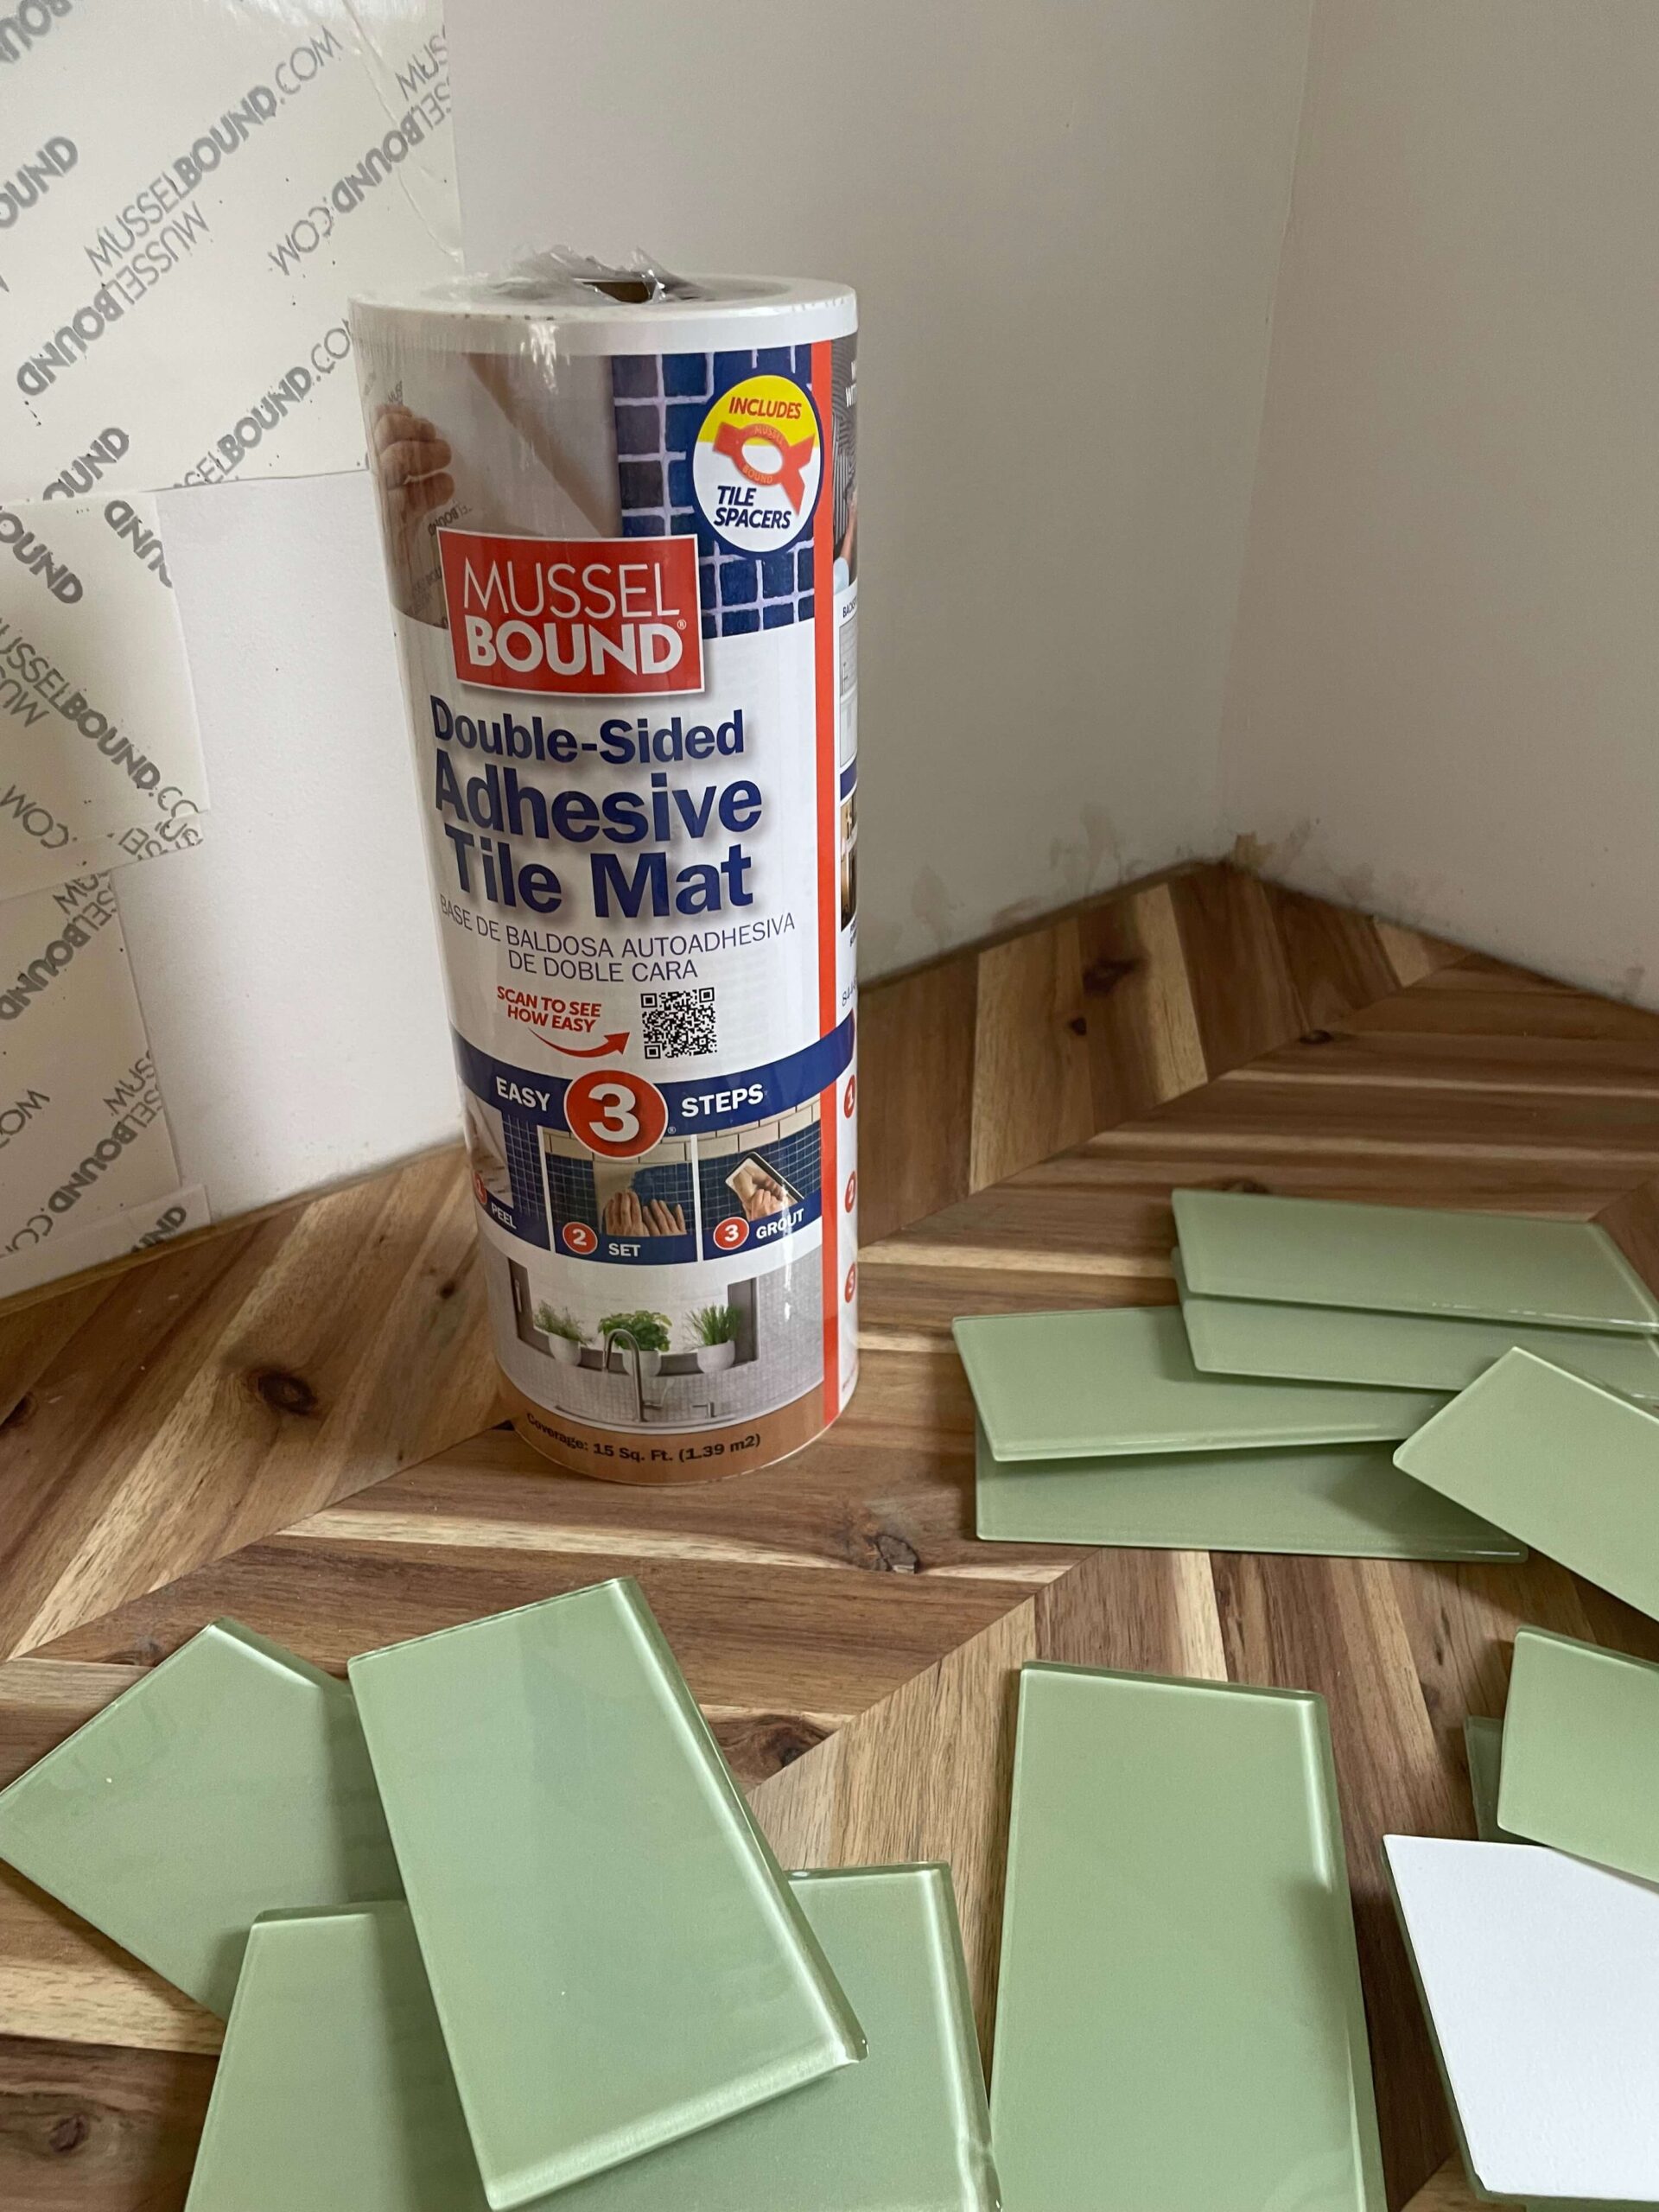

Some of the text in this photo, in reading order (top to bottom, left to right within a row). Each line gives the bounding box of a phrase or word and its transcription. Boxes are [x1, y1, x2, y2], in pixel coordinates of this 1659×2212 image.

[84, 24, 344, 278] MUSSELBOUND.COM
[728, 397, 802, 419] INCLUDES
[716, 485, 757, 507] TILE
[713, 507, 792, 530] SPACERS
[463, 556, 681, 620] MUSSEL
[429, 694, 745, 765] Double-Sided
[435, 747, 763, 844] Adhesive
[443, 822, 753, 919] Tile Mat
[439, 893, 796, 958] BASE DE BALDOSA AUTOADHESIVA
[508, 949, 699, 982] DE DOBLE CARA
[497, 985, 602, 1018] SCAN TO SEE
[507, 1004, 597, 1033] HOW EASY
[495, 1076, 765, 1143] EASY 3 STEPS
[491, 1202, 518, 1230] PEEL
[756, 1208, 804, 1239] GROUT
[572, 1228, 587, 1246] 2
[724, 1224, 739, 1242] 3
[608, 1243, 641, 1258] SET
[525, 1412, 762, 1463] Coverage: 15 Sq. Ft. (1.39 m2)
